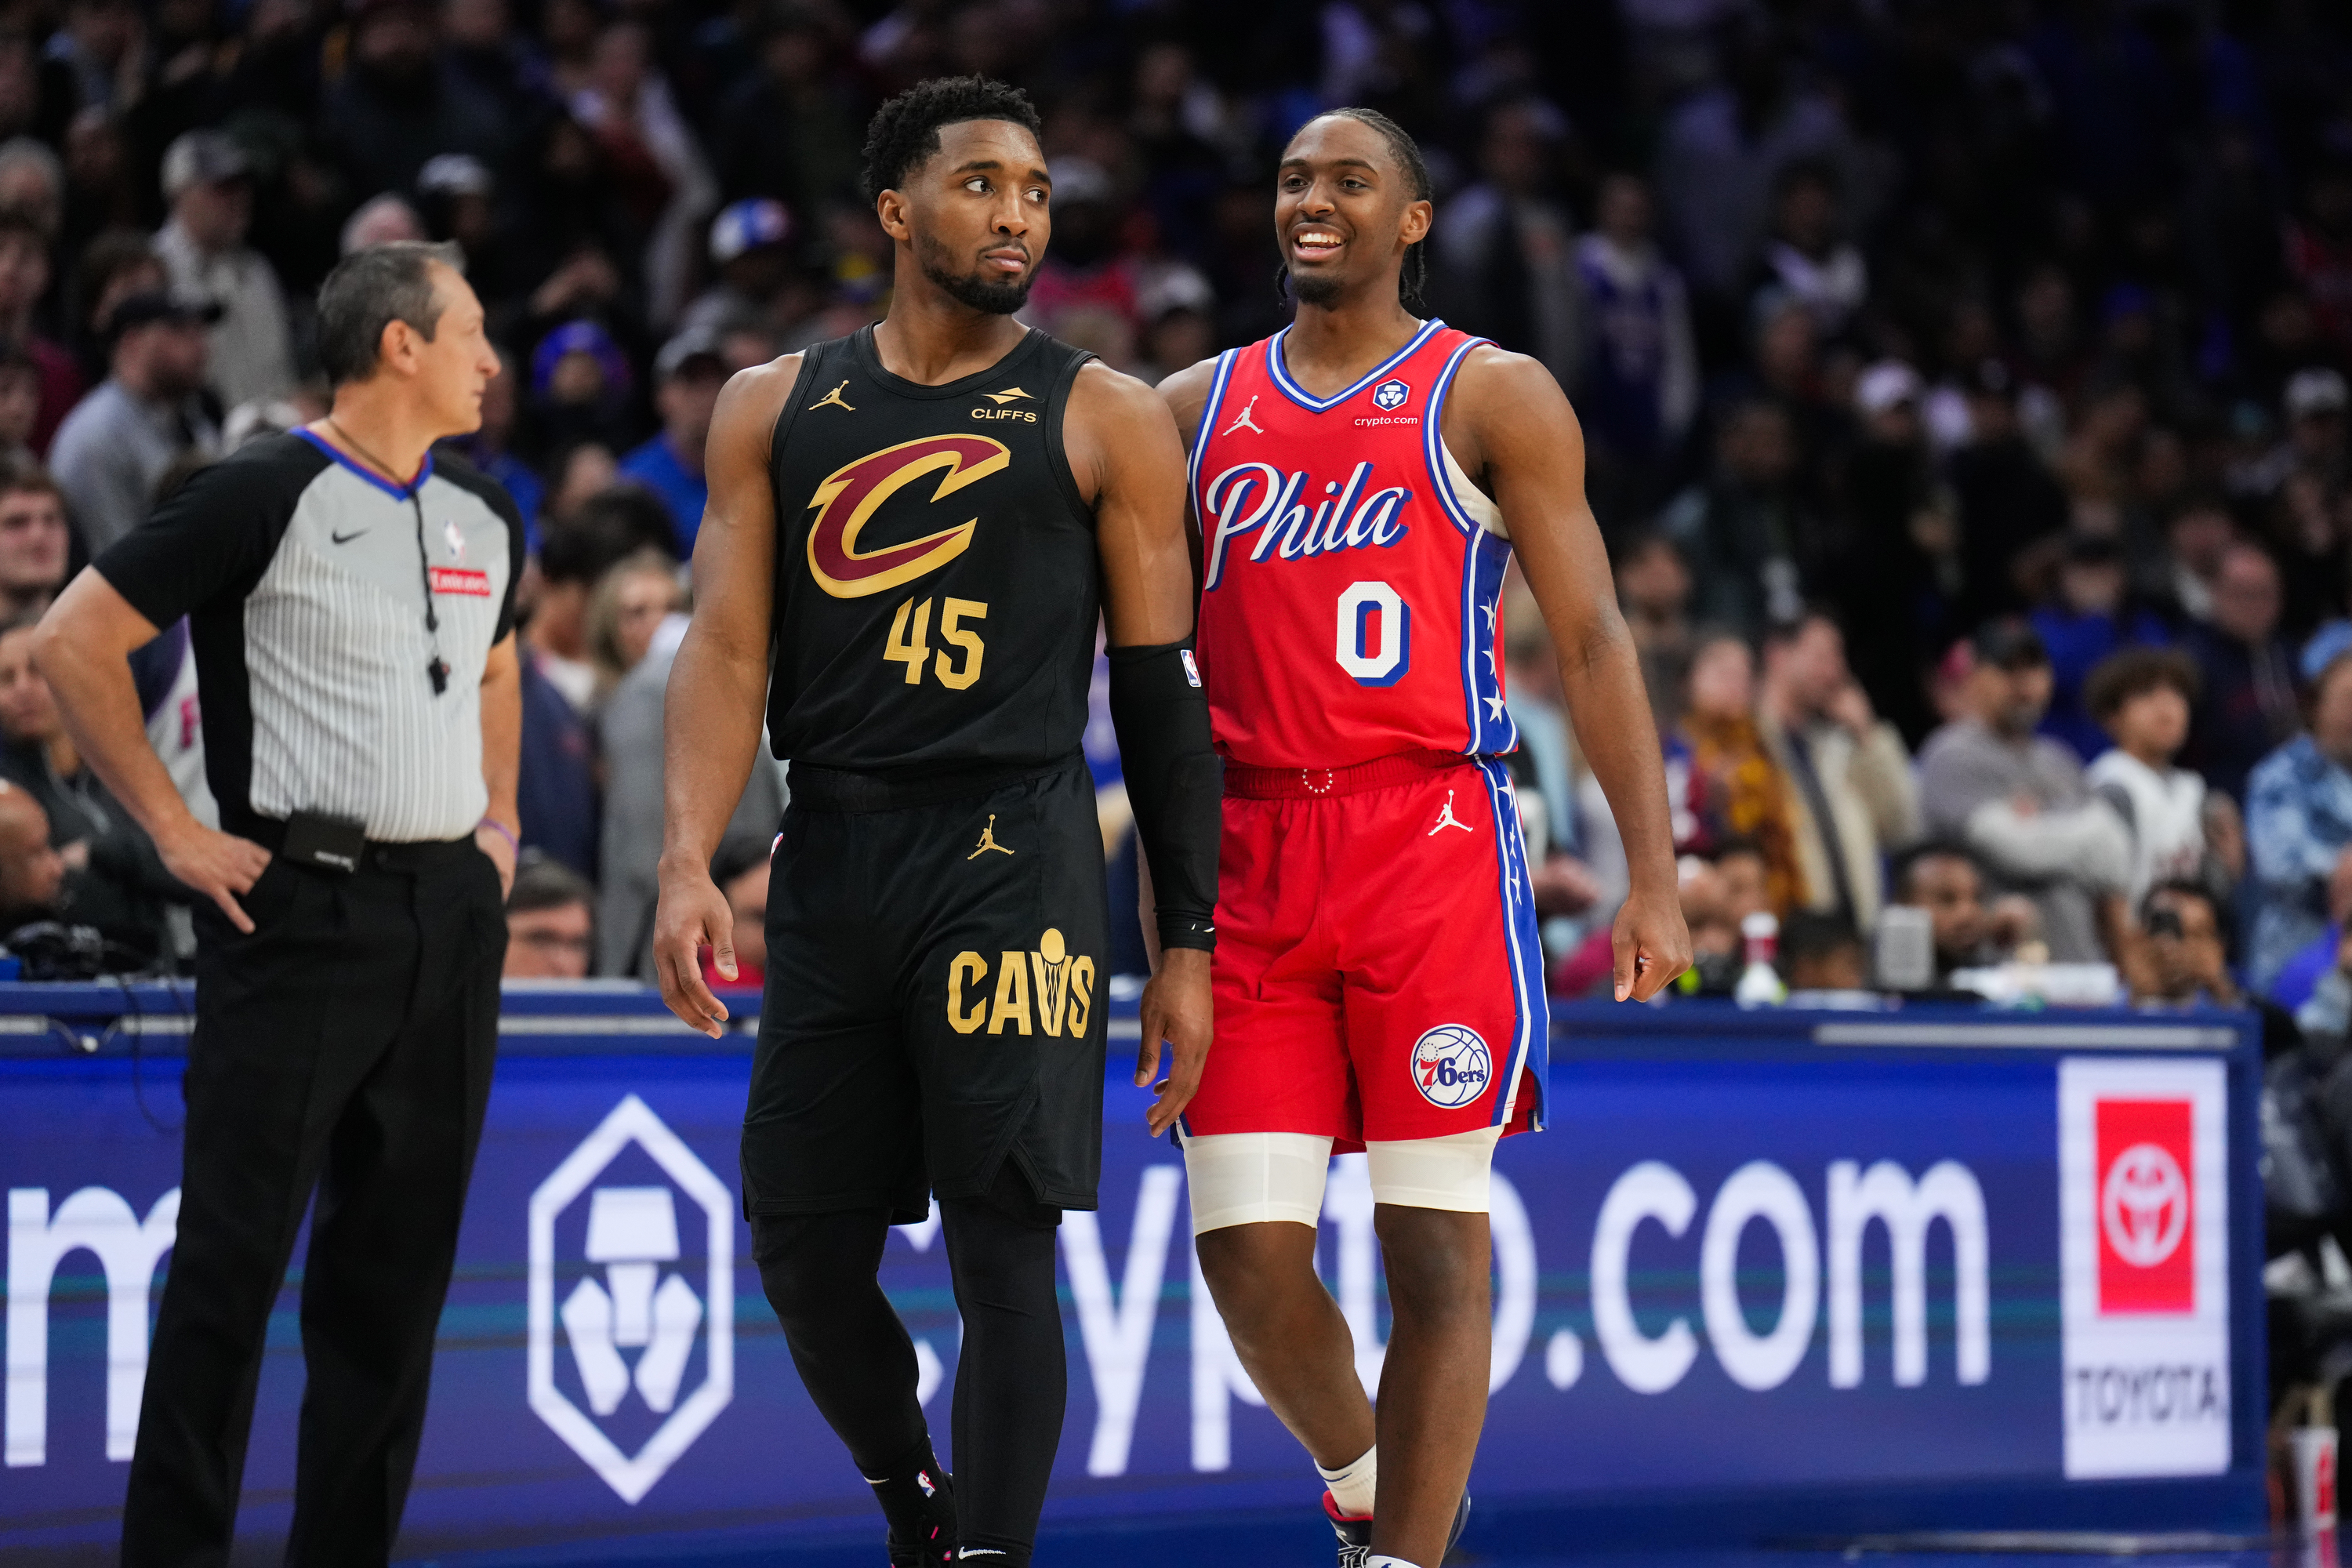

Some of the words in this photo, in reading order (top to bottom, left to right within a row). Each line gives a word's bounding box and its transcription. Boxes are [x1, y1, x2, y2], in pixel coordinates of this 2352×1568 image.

[971, 408, 1037, 423] CLIFFS
[1354, 416, 1418, 427] crypto.com
[807, 433, 1011, 599] C
[1204, 461, 1414, 592] Phila
[883, 596, 989, 691] 45
[1335, 581, 1411, 688] 0
[947, 949, 1095, 1039] CAVS
[1420, 1057, 1486, 1087] 76ers
[2067, 1366, 2223, 1426] TOYOTA
